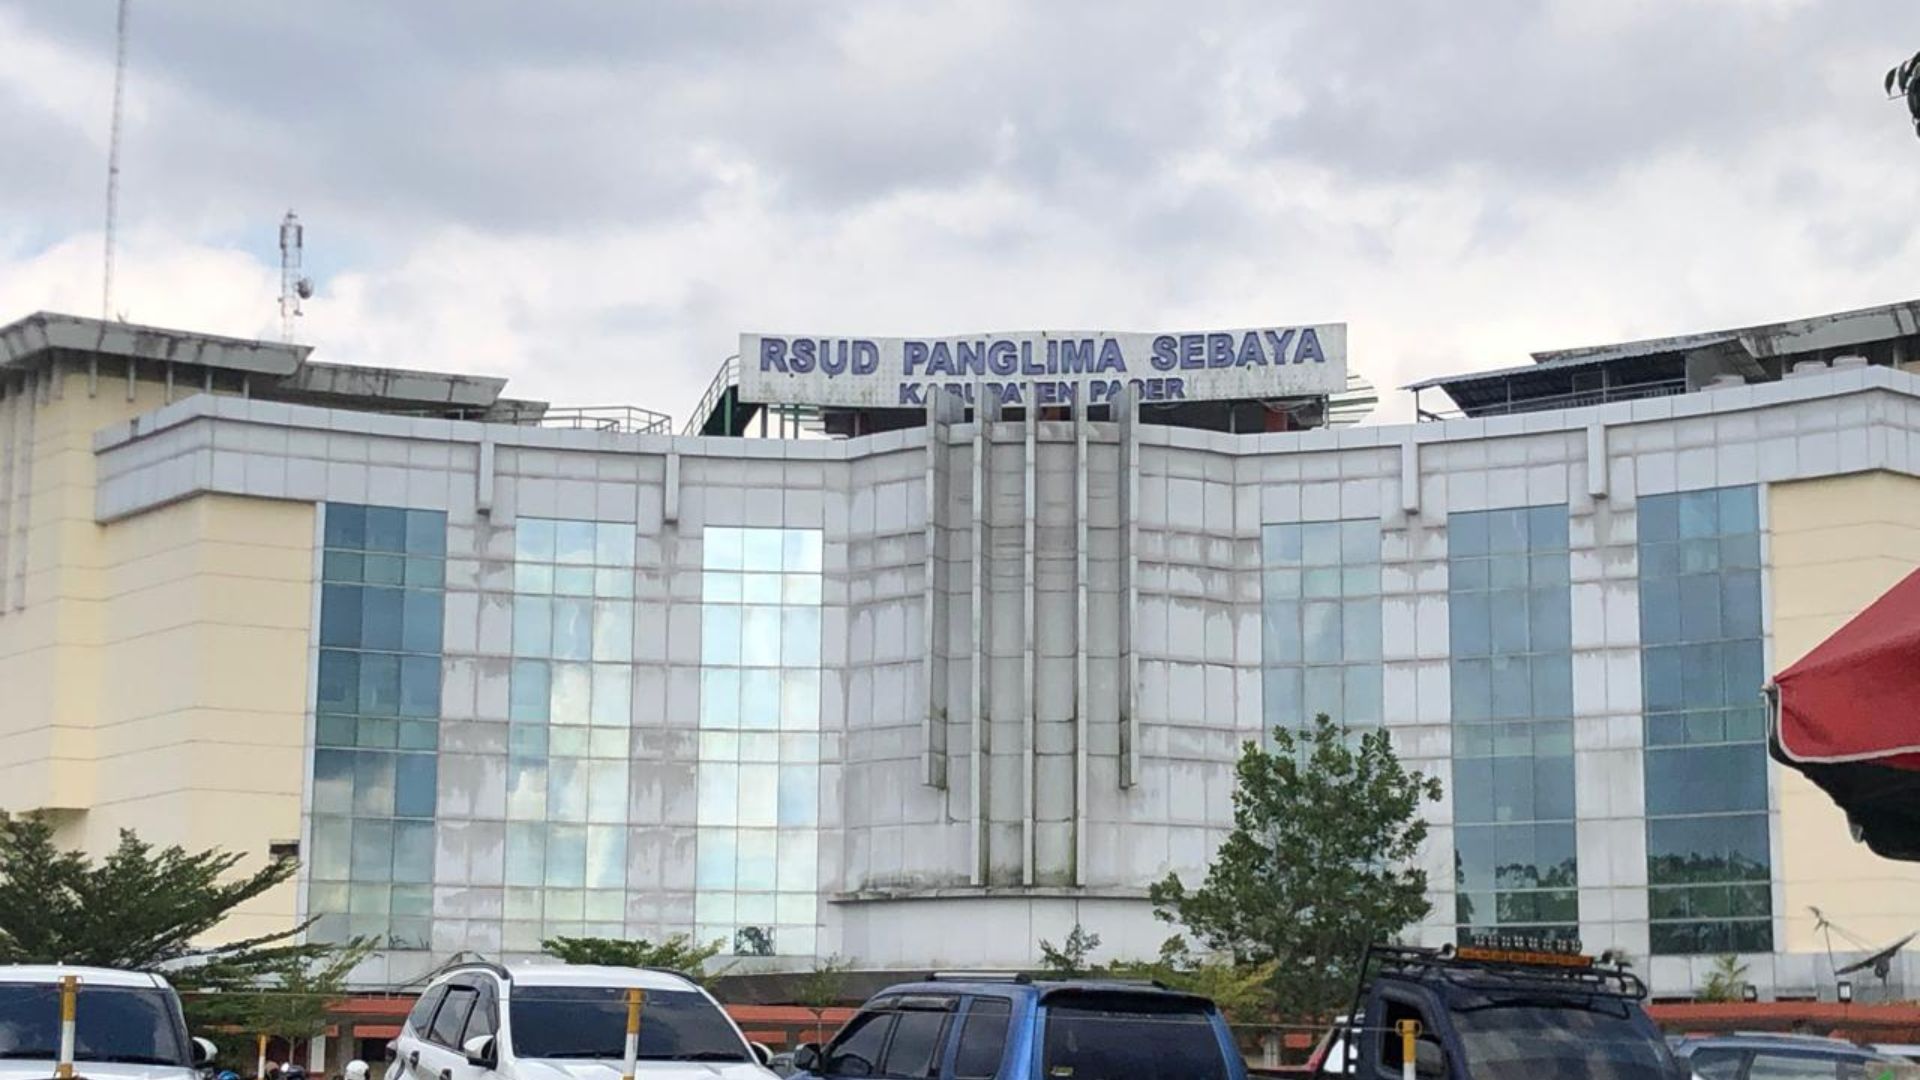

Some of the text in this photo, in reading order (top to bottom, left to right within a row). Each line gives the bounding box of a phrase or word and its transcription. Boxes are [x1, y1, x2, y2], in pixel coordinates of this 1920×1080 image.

[760, 327, 1326, 375] RSUD PANGLIMA SEBAYA
